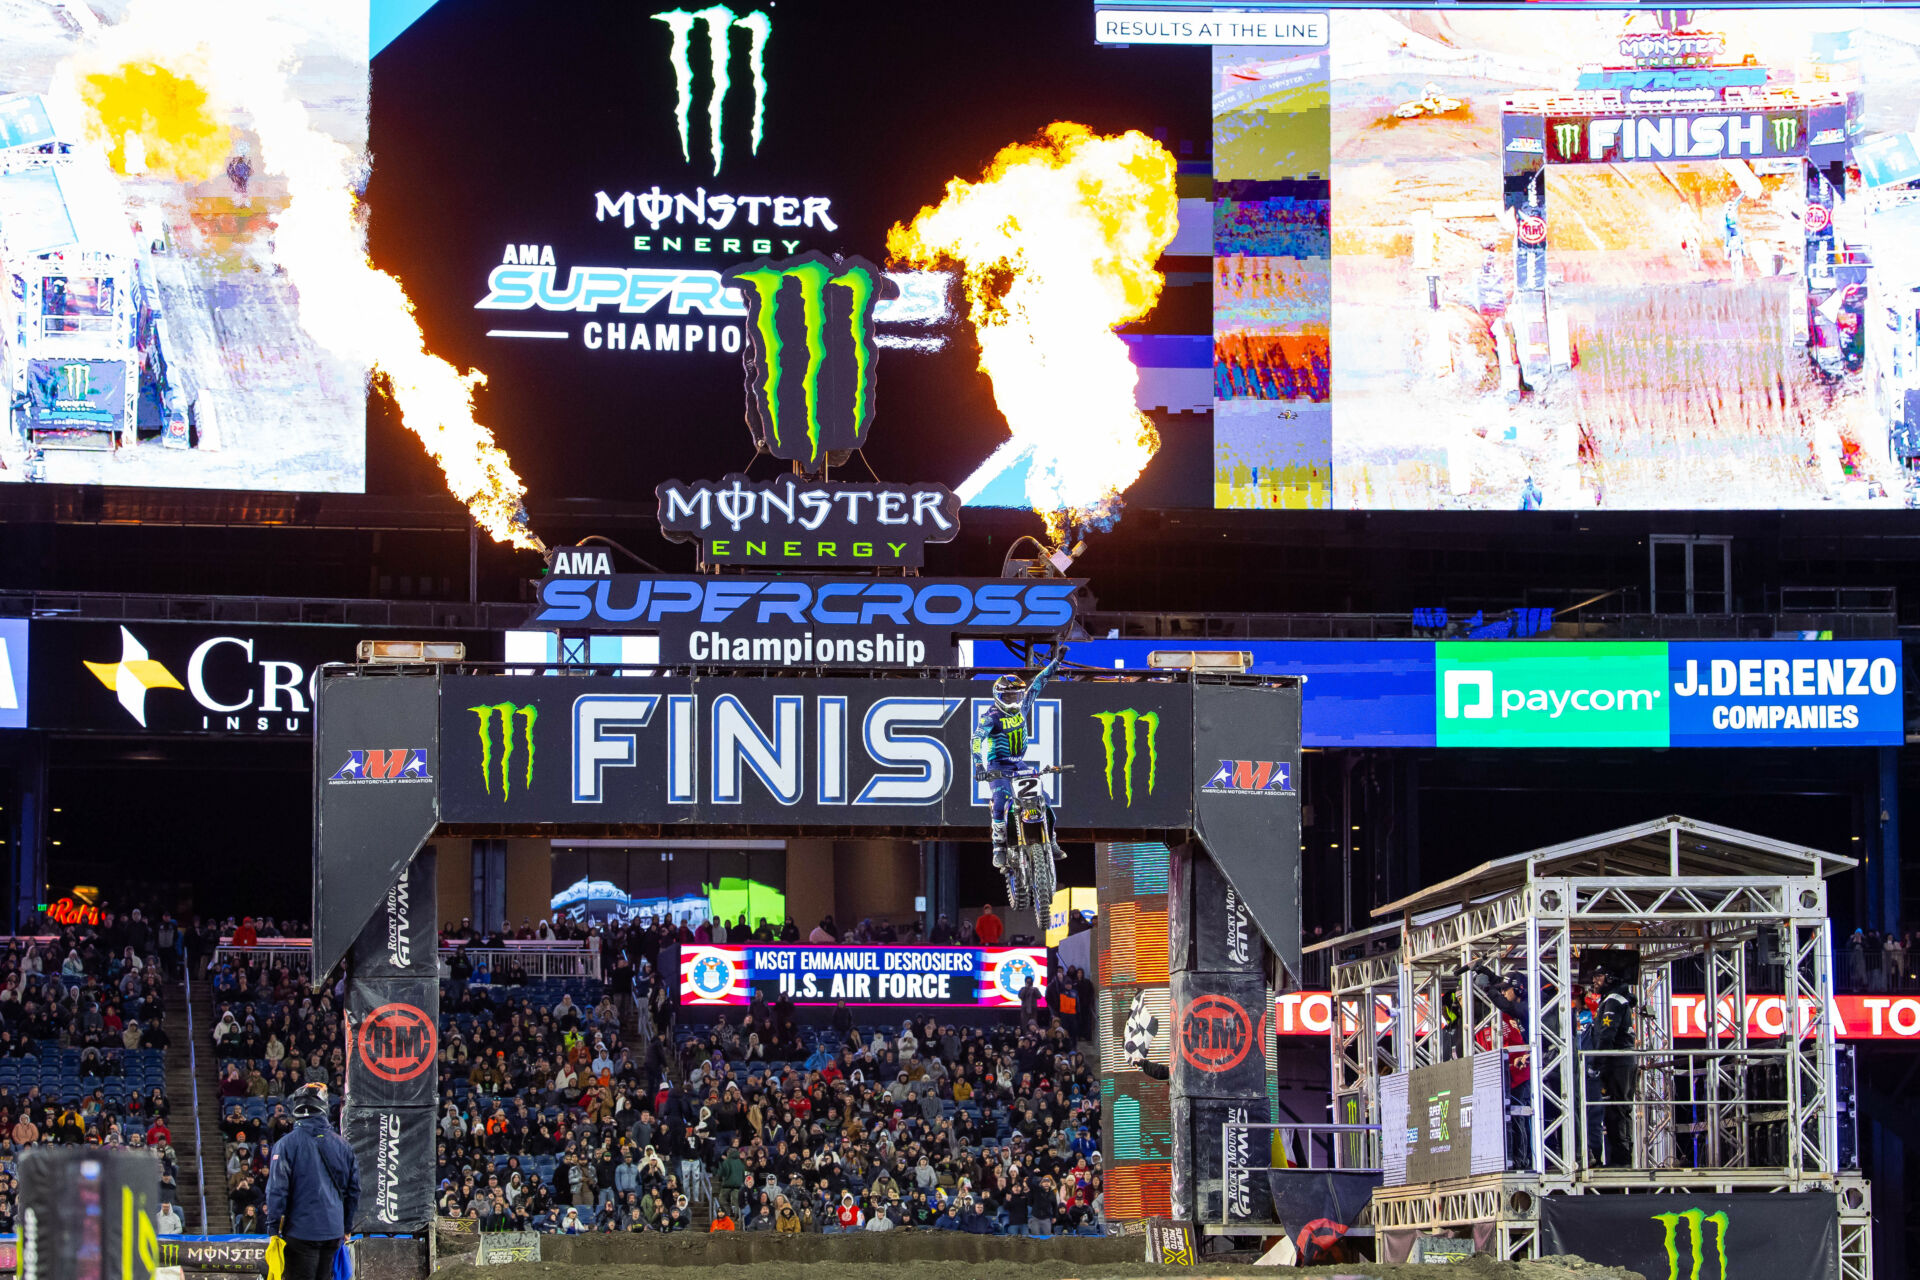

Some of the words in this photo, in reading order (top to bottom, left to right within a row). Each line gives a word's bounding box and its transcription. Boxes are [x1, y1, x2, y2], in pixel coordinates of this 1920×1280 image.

[1106, 21, 1193, 37] RESULTS
[1199, 23, 1223, 37] AT
[1229, 24, 1268, 38] THE
[1275, 24, 1318, 38] LINE
[1588, 115, 1764, 160] FINISH
[595, 186, 838, 232] MONSTER
[502, 244, 556, 265] AMA
[634, 235, 801, 255] ENERGY
[666, 481, 953, 531] MONSTER
[554, 552, 611, 575] AMA
[712, 540, 908, 558] ENERGY
[536, 579, 1078, 626] SUPERCROSS
[689, 631, 925, 667] Championship
[1674, 657, 1897, 697] J.DERENZO
[1501, 689, 1654, 719] paycom
[1712, 705, 1859, 730] COMPANIES
[328, 748, 434, 780] AMA
[1201, 759, 1297, 791] AMA
[1018, 779, 1038, 798] 2
[387, 885, 397, 914] MOU
[388, 916, 397, 951] ROCKY
[1227, 912, 1236, 947] ROCKY
[754, 950, 796, 970] MSGT
[800, 951, 880, 971] EMMANUEL
[885, 952, 973, 972] DESROSIERS
[779, 973, 823, 998] U.S.
[830, 973, 871, 998] AIR
[878, 973, 950, 998] FORCE
[373, 1025, 422, 1059] RM
[1192, 1016, 1237, 1050] RM
[377, 1113, 388, 1170] MOUNTAIN
[376, 1175, 387, 1207] ROCKY
[1228, 1166, 1238, 1200] ROCKY
[1162, 1227, 1171, 1249] CROSS
[1169, 1228, 1177, 1249] MOTO
[1174, 1227, 1184, 1250] SUPER
